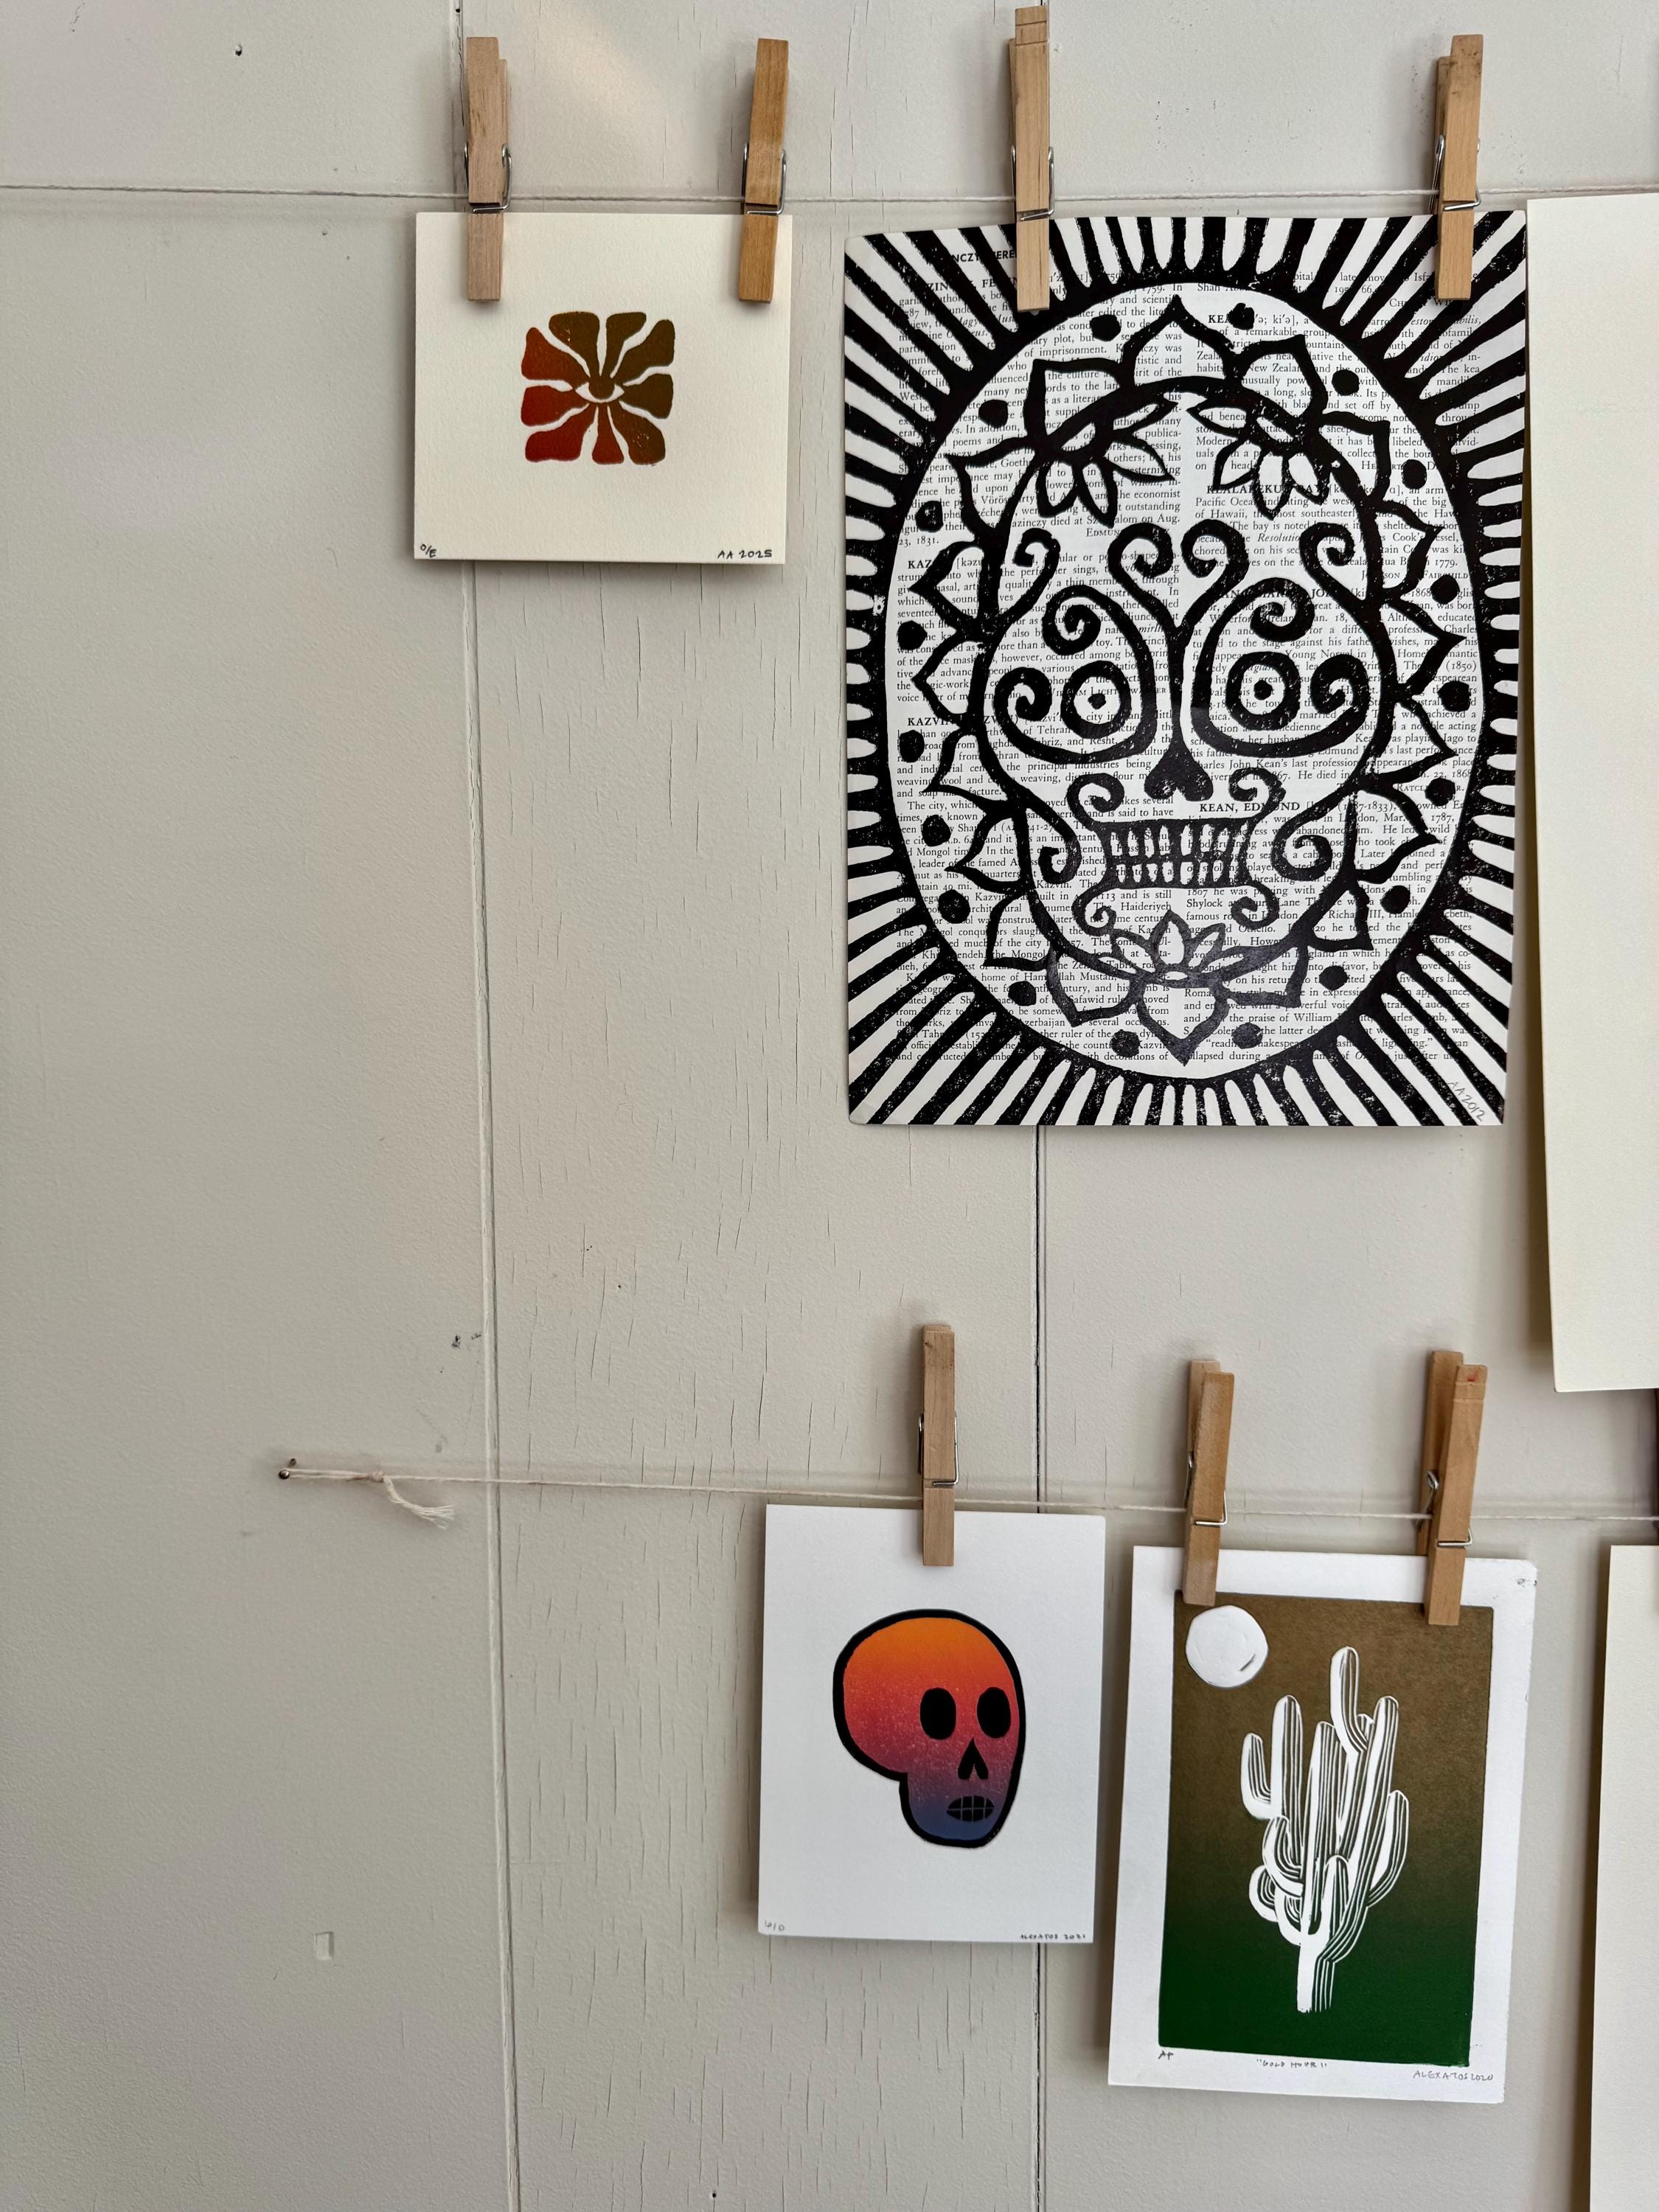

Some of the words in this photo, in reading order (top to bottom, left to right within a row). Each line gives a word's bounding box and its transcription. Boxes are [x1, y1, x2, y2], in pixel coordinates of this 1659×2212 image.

[1120, 296, 1136, 304] and
[1099, 307, 1127, 316] edited
[1054, 335, 1074, 346] plot,
[1040, 347, 1106, 358] imprisonment.
[1007, 361, 1026, 370] who
[1165, 355, 1181, 364] and
[1048, 372, 1062, 380] the
[1168, 368, 1181, 376] the
[984, 388, 1009, 399] many
[1274, 389, 1296, 398] long,
[1363, 400, 1374, 409] off
[953, 438, 981, 449] poems
[1145, 428, 1180, 437] publica-
[1349, 437, 1362, 445] has
[1114, 453, 1145, 462] others;
[995, 473, 1012, 481] may
[986, 486, 1008, 495] upon
[1196, 498, 1225, 506] Pacific
[1432, 497, 1446, 507] big
[1126, 502, 1180, 512] outstanding
[1211, 509, 1248, 518] Hawaii,
[1051, 517, 1072, 525] died
[1158, 515, 1180, 524] Aug.
[1253, 521, 1268, 532] bay
[917, 538, 939, 546] 1831.
[717, 549, 734, 559] AA
[738, 549, 772, 559] 2025
[1281, 557, 1294, 566] the
[1436, 558, 1457, 568] 1779.
[1073, 566, 1098, 574] sings,
[1012, 629, 1029, 637] also
[1096, 640, 1113, 649] toy.
[1243, 639, 1256, 647] the
[1291, 639, 1323, 647] against
[1329, 637, 1341, 646] his
[1001, 654, 1042, 663] however,
[1090, 653, 1120, 661] among
[1286, 650, 1315, 660] Young
[1446, 663, 1476, 671] (1850)
[1246, 699, 1256, 708] he
[1087, 713, 1102, 724] city
[1449, 722, 1476, 731] acting
[897, 765, 913, 773] and
[1127, 759, 1151, 771] being
[1229, 760, 1250, 769] John
[1298, 771, 1312, 779] He
[1317, 770, 1335, 779] died
[1020, 775, 1060, 784] weaving,
[908, 801, 925, 810] The
[929, 801, 947, 810] city,
[1200, 804, 1238, 813] KEAN,
[947, 812, 977, 820] known
[1119, 809, 1135, 817] said
[1431, 815, 1454, 824] 1787,
[1383, 825, 1397, 833] He
[917, 847, 950, 858] Mongol
[1000, 846, 1013, 854] the
[919, 860, 945, 868] leader
[978, 858, 1005, 866] famed
[1401, 860, 1418, 869] and
[947, 871, 959, 879] his
[1121, 890, 1137, 898] and
[1155, 889, 1172, 898] still
[1187, 889, 1208, 897] 1807
[1121, 902, 1171, 914] Haideriyeh
[1186, 899, 1222, 908] Shylock
[1186, 911, 1219, 920] famous
[1386, 922, 1400, 931] the
[1026, 939, 1041, 947] city
[1012, 950, 1046, 961] Mongol
[1010, 972, 1019, 981] of
[1249, 1015, 1275, 1024] praise
[1279, 1013, 1289, 1021] of
[1294, 1013, 1332, 1021] William
[1085, 1029, 1094, 1037] of
[1230, 1052, 1260, 1061] during
